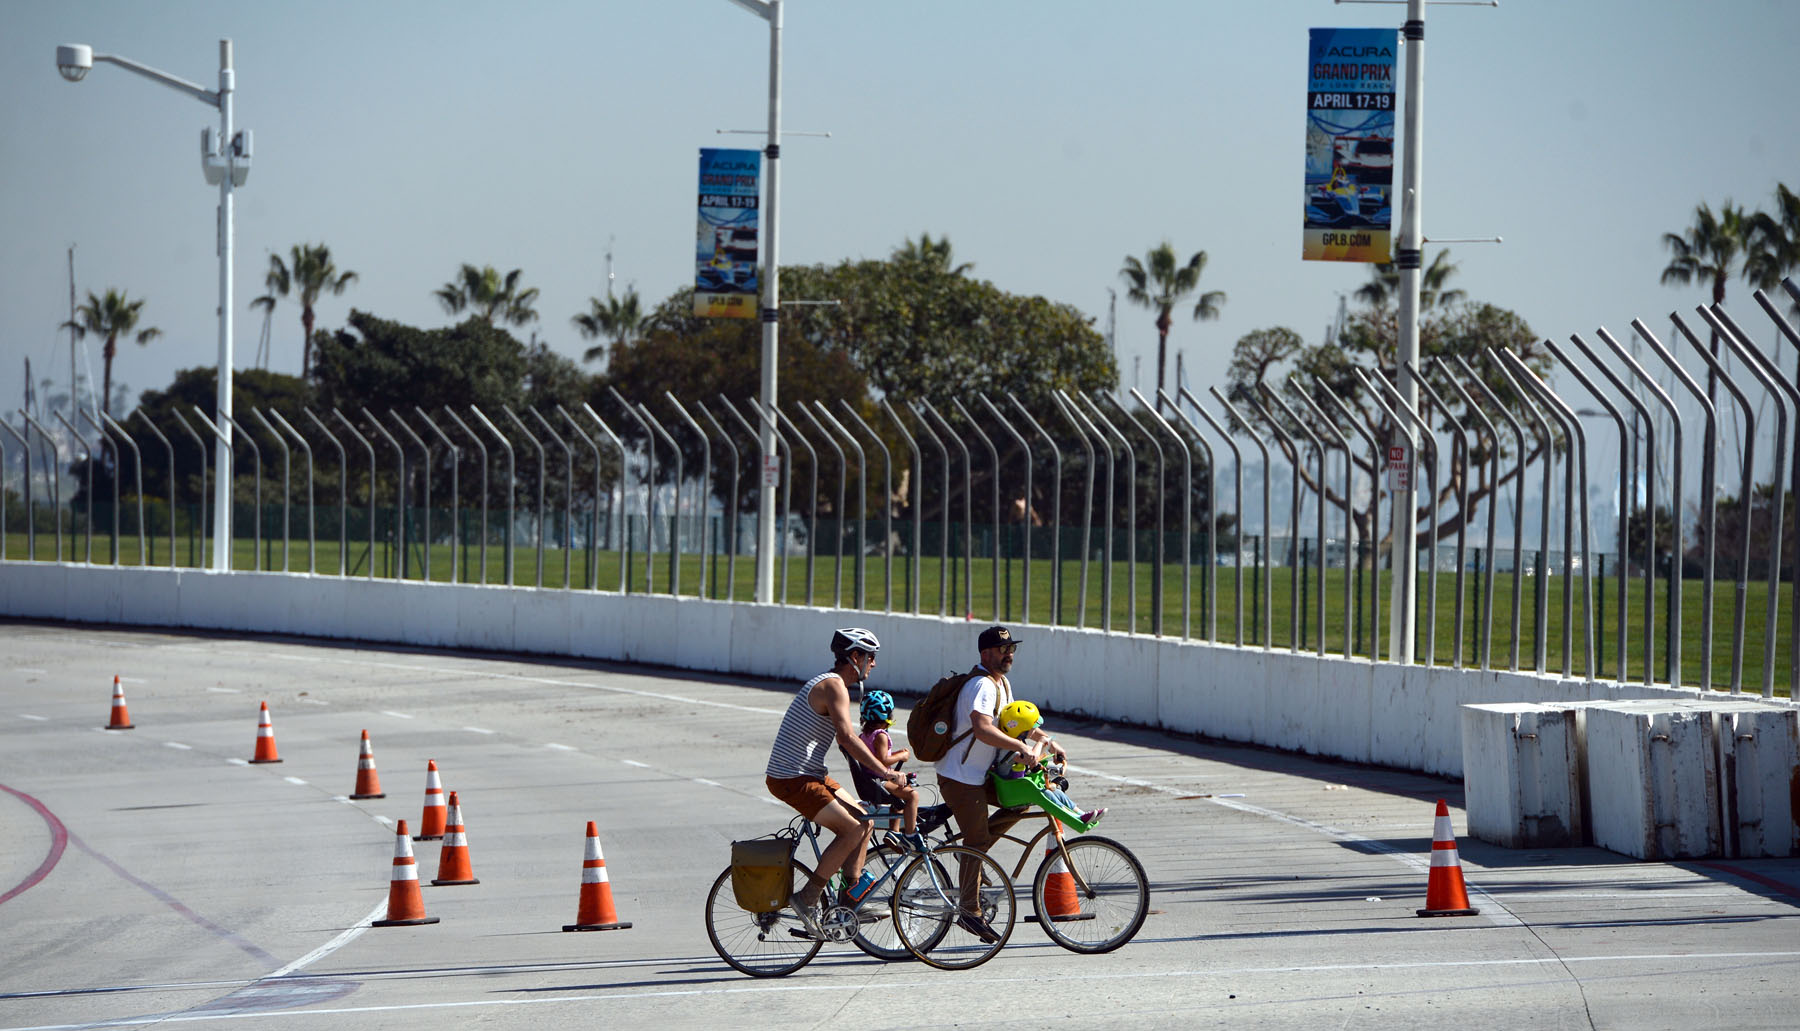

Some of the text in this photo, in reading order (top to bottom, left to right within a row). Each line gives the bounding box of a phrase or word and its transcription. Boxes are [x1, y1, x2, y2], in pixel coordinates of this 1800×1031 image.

[1328, 46, 1392, 57] ACURA
[1314, 63, 1391, 80] GRAND PRIX
[1313, 93, 1390, 109] APRIL 17-19
[703, 174, 755, 186] GRAND PRIX
[702, 196, 755, 207] APRIL 17-19
[1322, 233, 1371, 246] GPLB.COM
[1391, 450, 1402, 459] NO
